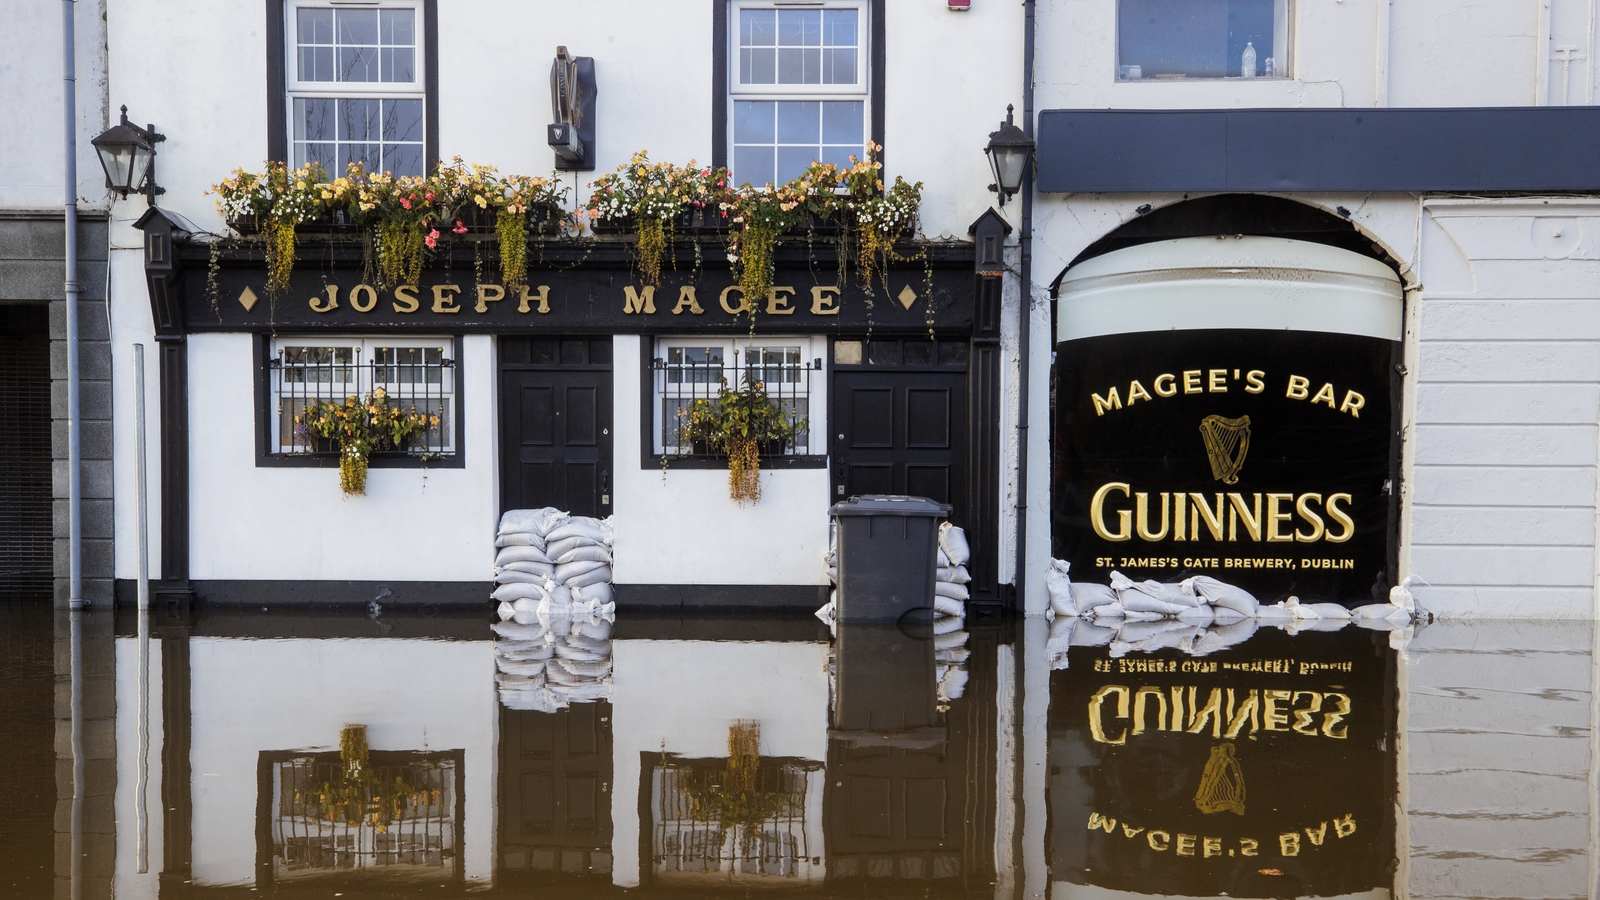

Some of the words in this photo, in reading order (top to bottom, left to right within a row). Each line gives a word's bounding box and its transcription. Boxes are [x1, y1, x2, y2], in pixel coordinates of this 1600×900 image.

[308, 284, 551, 314] JOSEPH
[623, 285, 841, 315] MAGEE
[1091, 368, 1266, 417] MAGEE'S
[1285, 374, 1366, 419] BAR
[1090, 481, 1355, 543] GUINNESS
[1095, 557, 1115, 568] ST.
[1120, 557, 1179, 568] JAMES'S
[1183, 557, 1219, 568] GATE
[1224, 557, 1296, 570] BREWERY,
[1301, 558, 1354, 569] DUBLIN
